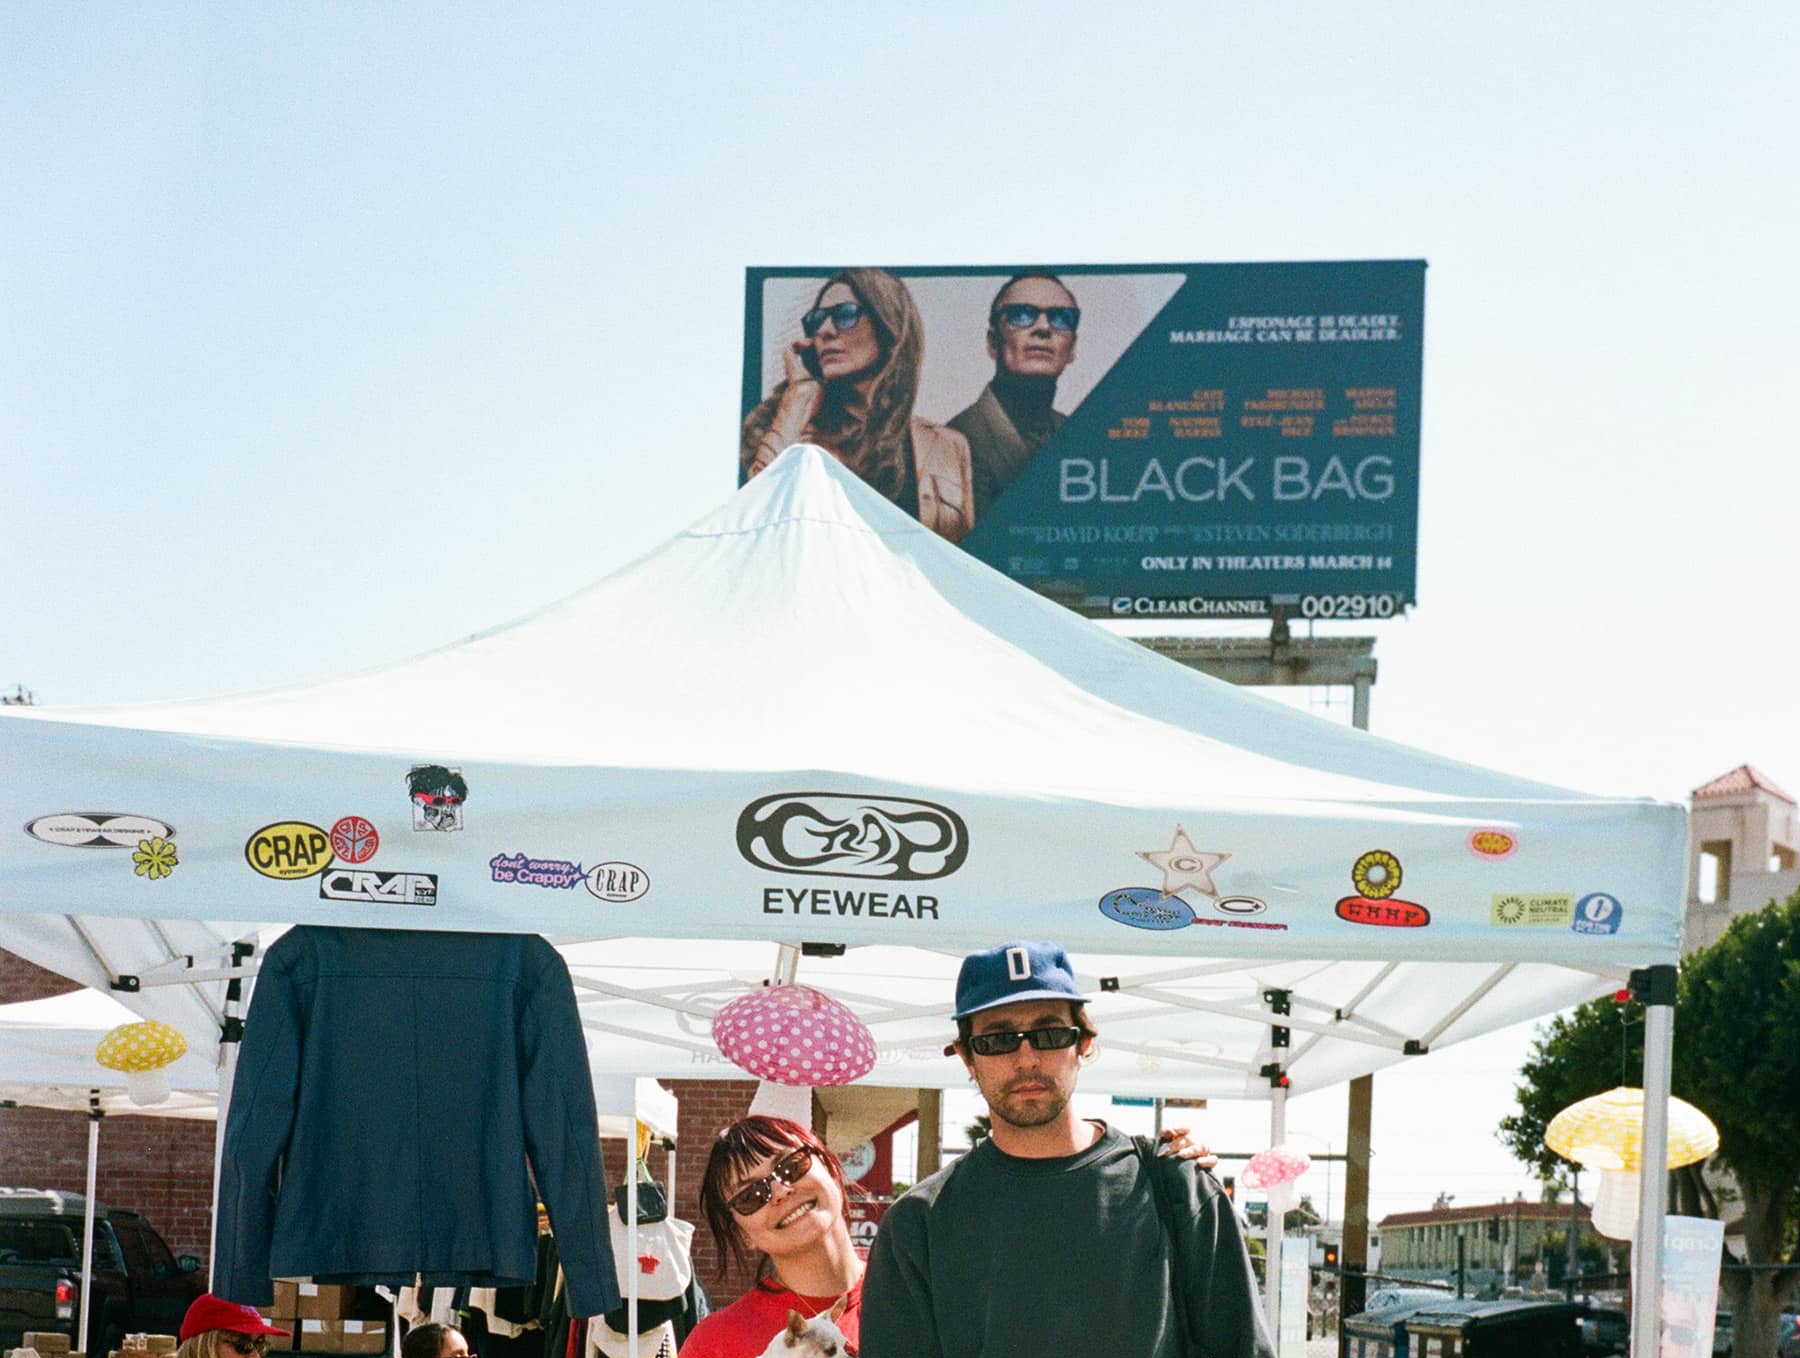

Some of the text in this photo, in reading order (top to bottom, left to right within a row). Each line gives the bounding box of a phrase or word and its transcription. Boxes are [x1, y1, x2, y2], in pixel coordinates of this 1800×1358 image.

[1169, 331, 1252, 343] MARRIAGE
[1256, 330, 1292, 342] CAN
[1059, 455, 1396, 503] BLACK BAG
[1046, 526, 1100, 543] DAVID
[1141, 557, 1188, 571] ONLY
[1192, 557, 1213, 570] IN
[1217, 556, 1305, 570] THEATERS
[1309, 556, 1373, 570] MARCH
[1301, 595, 1394, 618] 002910
[253, 834, 327, 869] CRAP
[322, 870, 436, 903] CRAP
[494, 869, 574, 887] be Crappy
[595, 868, 640, 893] CRAP
[763, 888, 939, 920] EYEWEAR
[1529, 898, 1569, 906] CLIMATE
